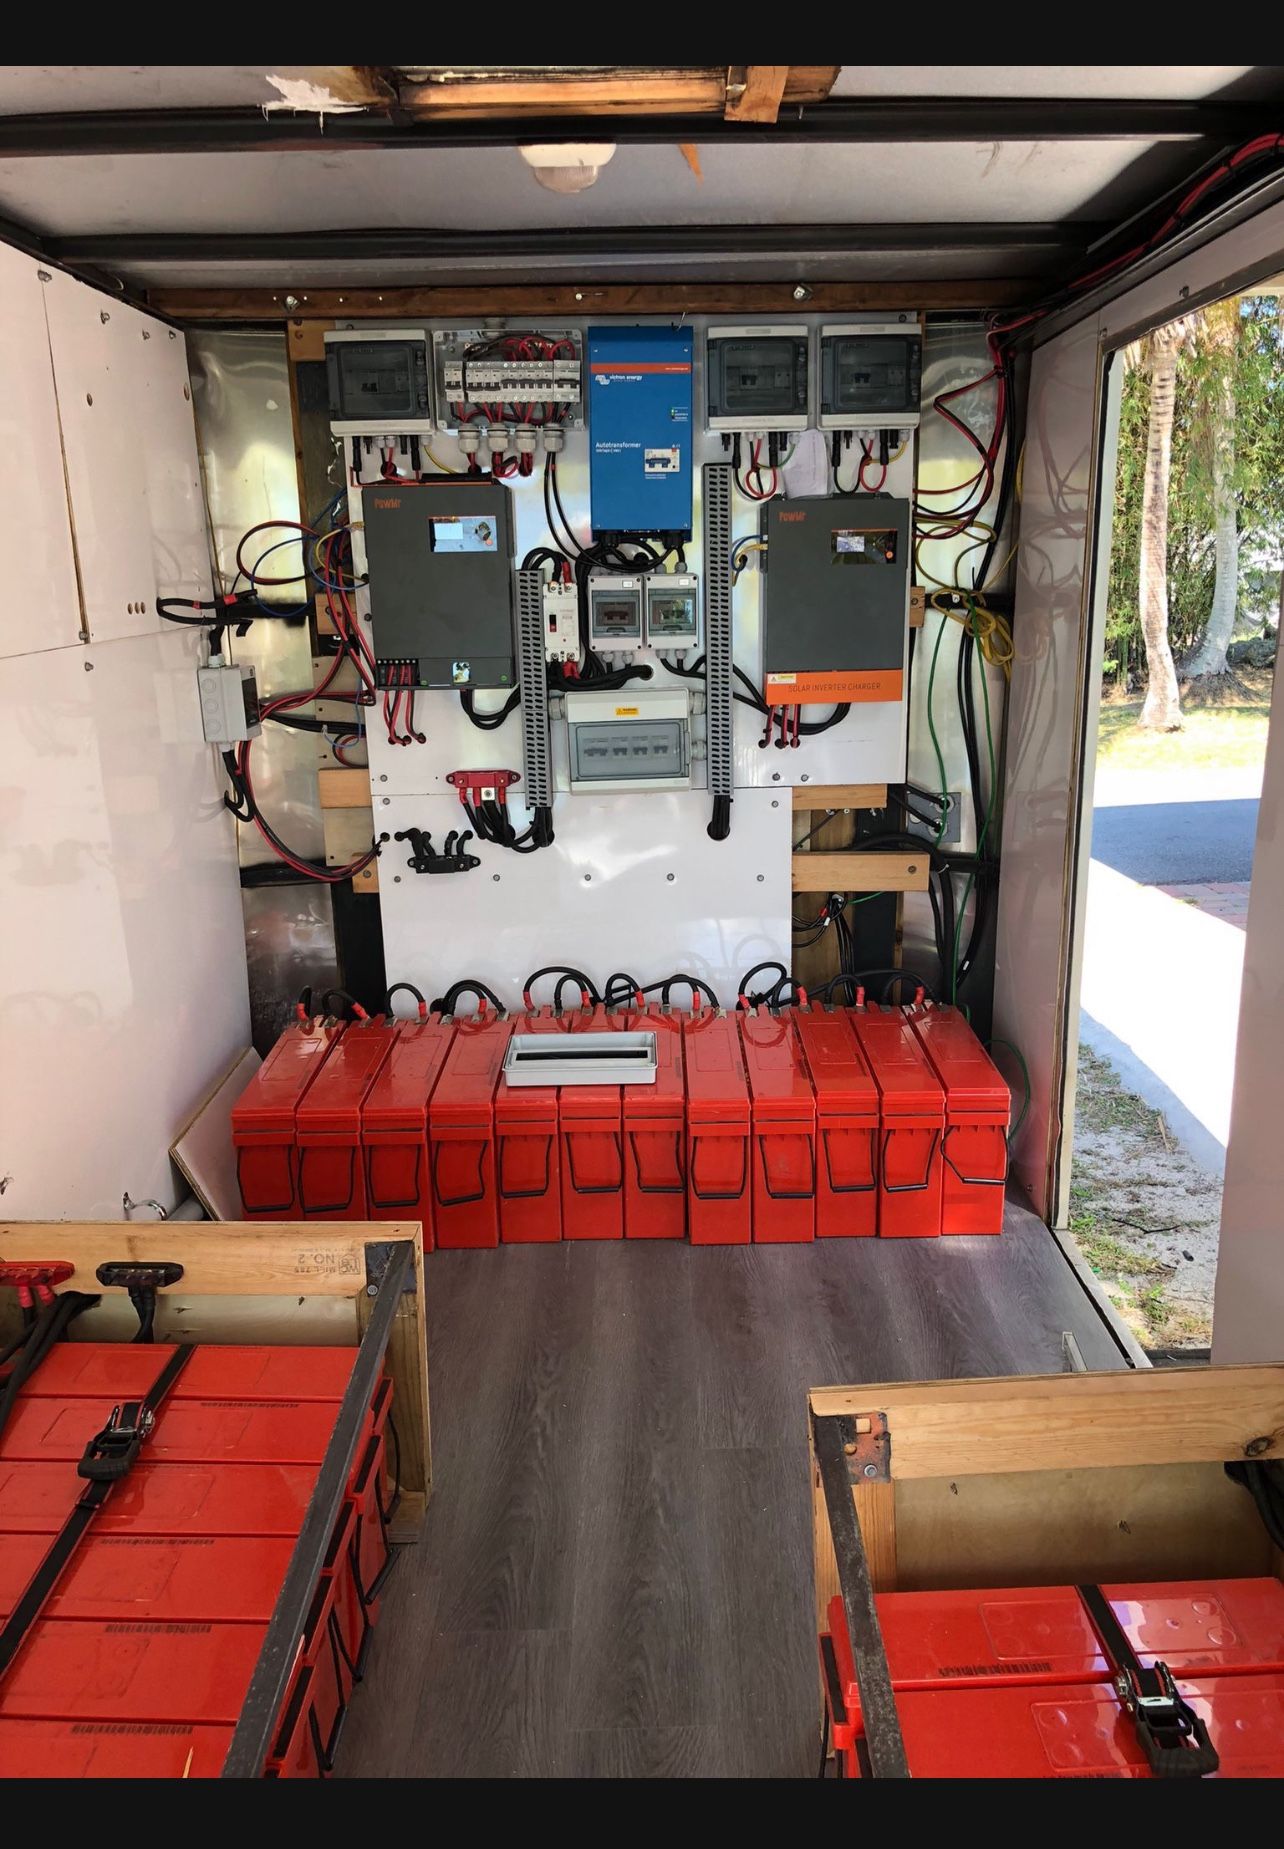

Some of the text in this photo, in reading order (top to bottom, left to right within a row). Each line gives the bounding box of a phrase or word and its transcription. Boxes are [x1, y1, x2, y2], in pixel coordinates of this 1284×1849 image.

[595, 441, 641, 449] Autotransformer
[789, 682, 881, 693] SOLAR INVERTER CHARGER
[298, 1253, 335, 1264] NO. 2
